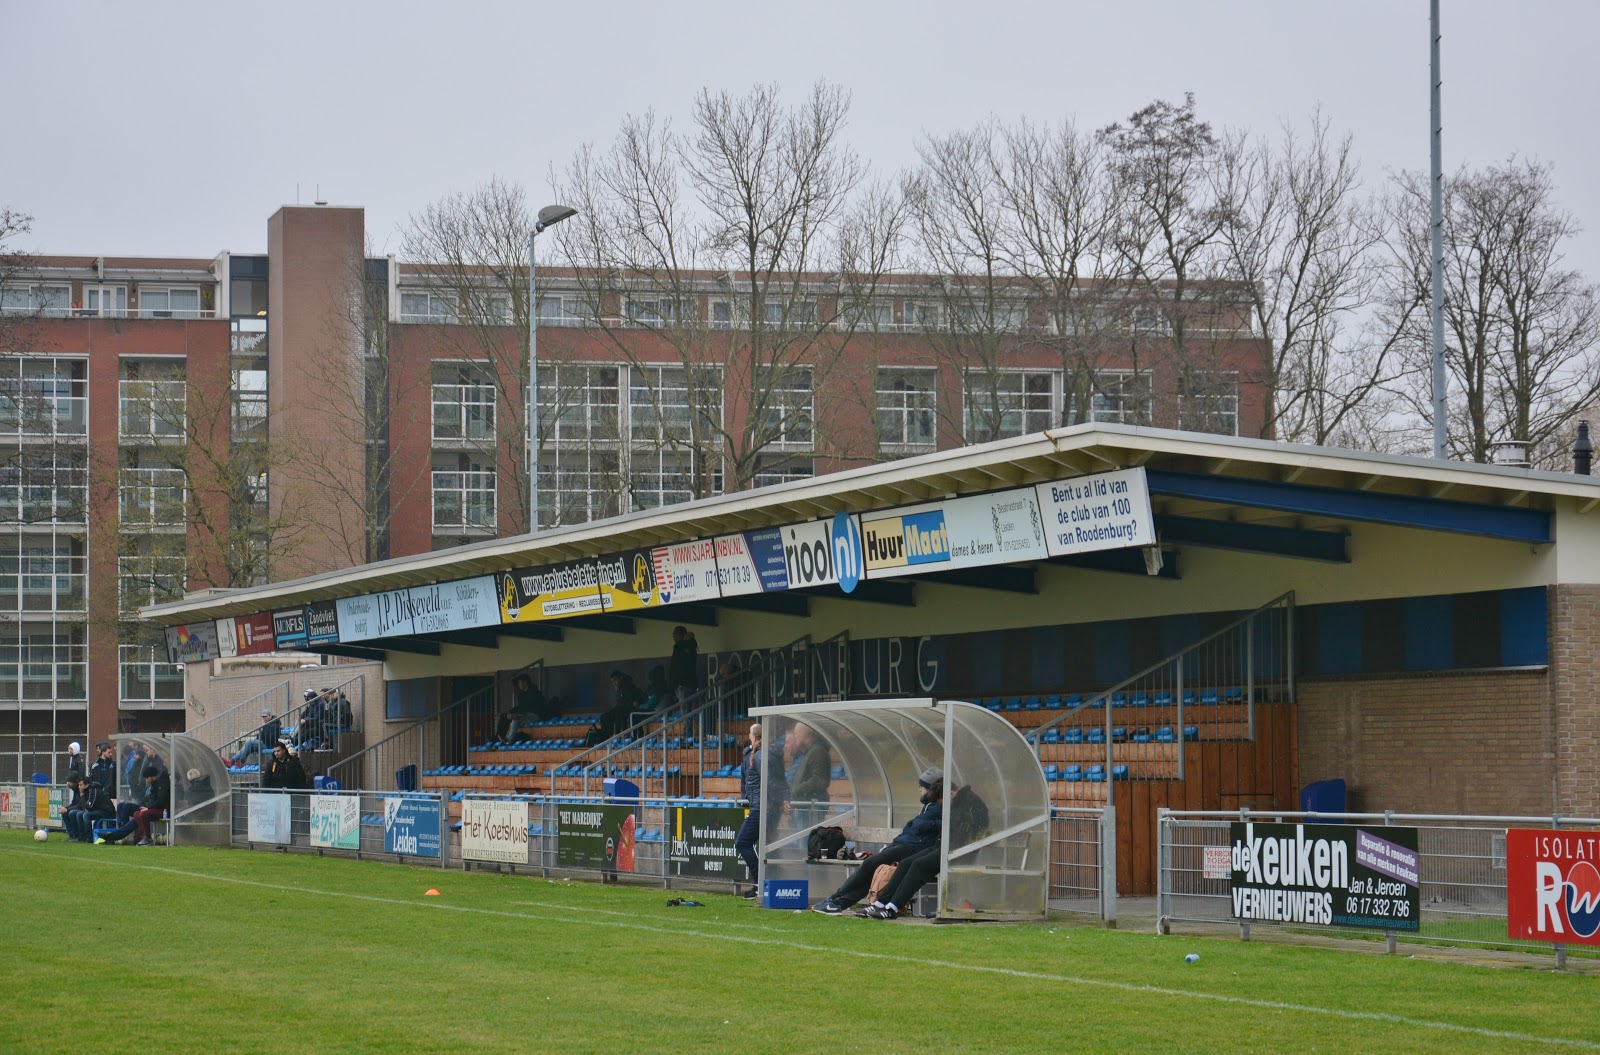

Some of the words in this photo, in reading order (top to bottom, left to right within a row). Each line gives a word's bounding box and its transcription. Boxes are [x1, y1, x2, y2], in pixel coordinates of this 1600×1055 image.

[1052, 485, 1074, 503] Bent
[1075, 487, 1082, 500] u
[1083, 481, 1093, 498] al
[1094, 479, 1107, 496] lid
[1109, 480, 1128, 494] van
[1057, 508, 1069, 524] de
[1071, 504, 1090, 523] club
[1092, 505, 1110, 519] van
[1112, 498, 1131, 516] 100
[866, 530, 904, 561] Huur
[904, 522, 949, 557] Maat
[1057, 532, 1075, 546] van
[1075, 519, 1137, 543] Roodenburg?
[672, 537, 744, 565] WWW.SJARDINBV.NL
[785, 522, 834, 585] riool
[834, 517, 857, 579] nl
[951, 542, 970, 557] dames
[970, 539, 977, 556] &
[977, 539, 994, 554] heren
[705, 570, 718, 588] 071
[719, 568, 731, 585] 531
[732, 566, 741, 583] 78
[742, 565, 751, 582] 39
[276, 616, 304, 634] MONFILS
[376, 594, 395, 635] J.P.
[470, 801, 492, 811] Brasserie
[493, 802, 520, 811] Restaurant
[392, 826, 418, 854] Leiden
[463, 809, 481, 838] Het
[484, 810, 528, 844] Koetshuis
[692, 825, 704, 839] Voor
[703, 825, 709, 839] al
[709, 829, 716, 840] uw
[716, 826, 736, 840] schilder
[690, 845, 697, 855] en
[696, 842, 725, 857] onderhouds
[725, 843, 737, 858] werk
[1246, 822, 1348, 888] keuken
[1361, 834, 1386, 854] Reparatie
[1385, 845, 1391, 857] &
[1391, 849, 1416, 867] renovatie
[1357, 849, 1367, 861] van
[1366, 853, 1377, 866] alle
[1376, 857, 1396, 874] merken
[1396, 863, 1418, 883] keukens
[775, 888, 802, 897] AMACX
[1348, 876, 1365, 894] Jan
[1366, 877, 1374, 895] &
[1375, 878, 1407, 896] Jeroen
[1232, 886, 1333, 925] VERNIEUWERS
[1346, 896, 1358, 914] 06
[1360, 897, 1371, 914] 17
[1372, 898, 1391, 916] 332
[1392, 899, 1411, 917] 796
